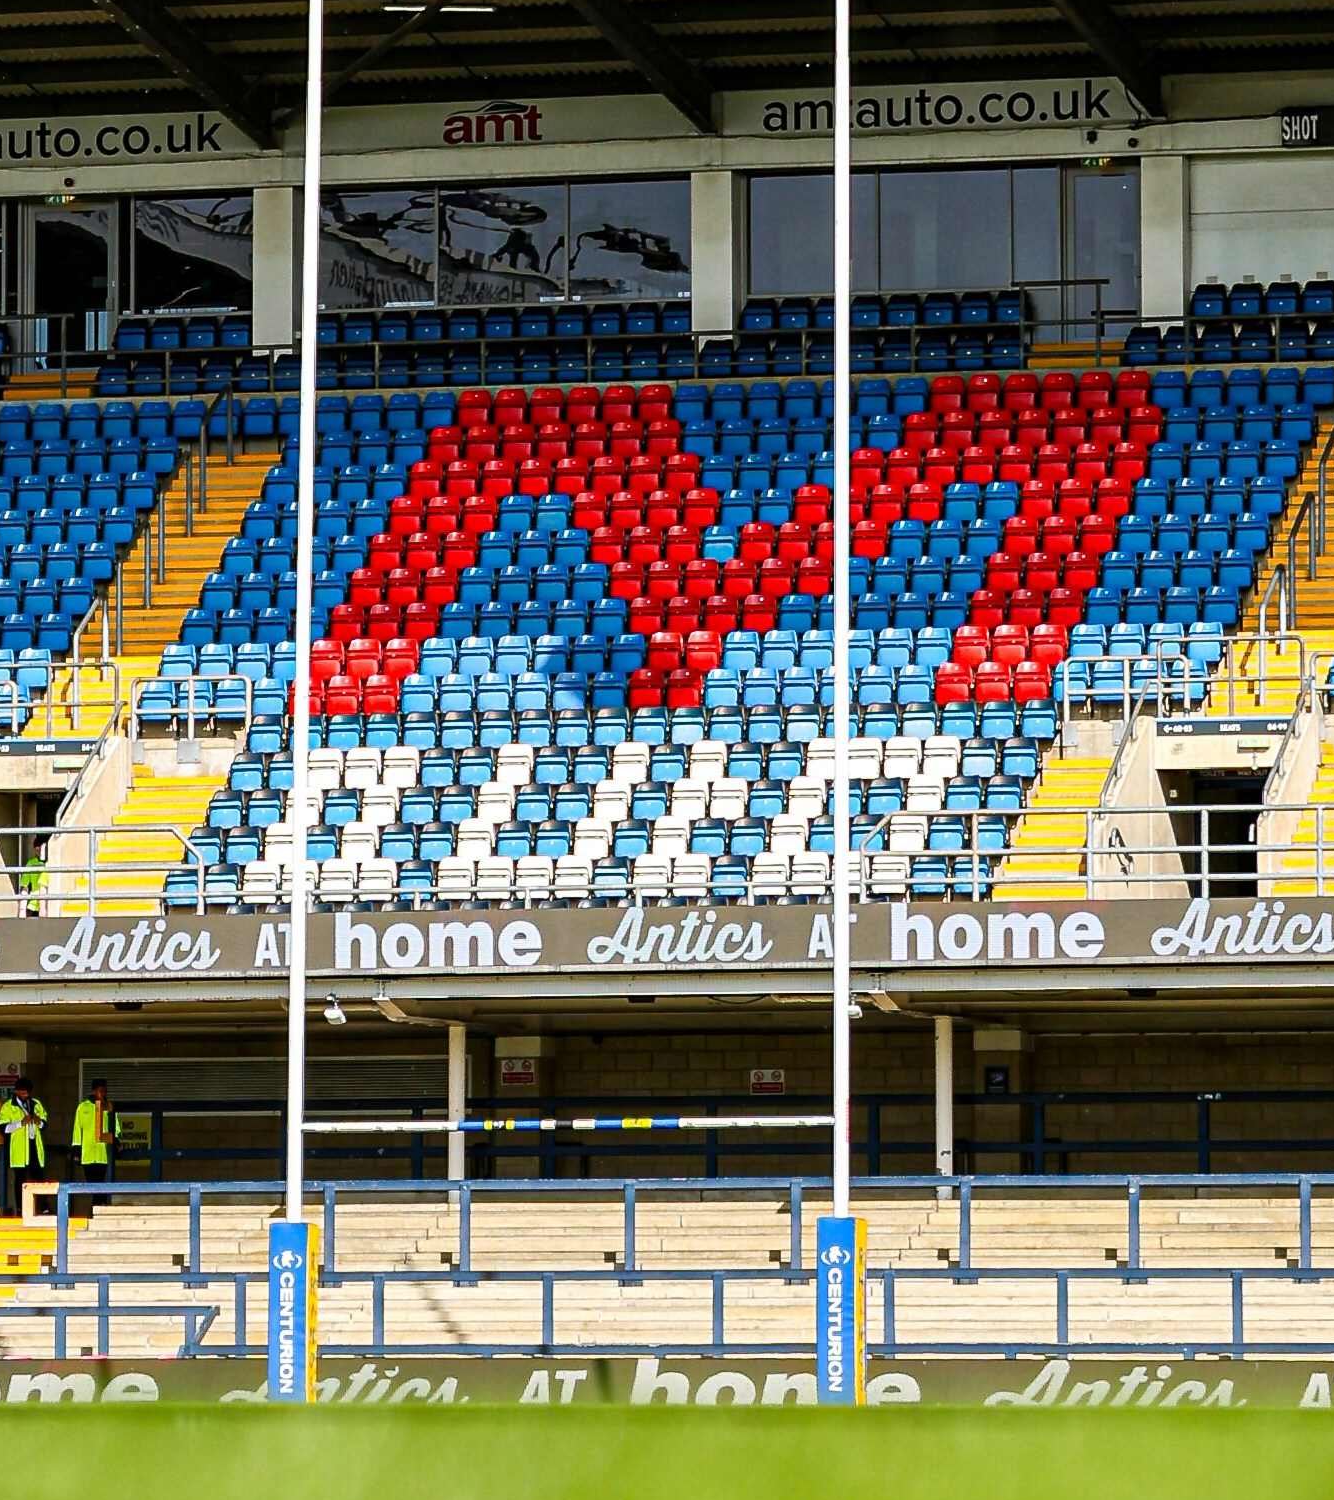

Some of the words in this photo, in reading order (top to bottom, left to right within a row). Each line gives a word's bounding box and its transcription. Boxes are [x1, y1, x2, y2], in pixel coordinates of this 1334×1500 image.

[443, 104, 543, 146] amt
[763, 79, 1111, 133] amauto.co.uk
[1282, 115, 1318, 140] SHOT
[40, 916, 221, 972] Antics
[335, 912, 543, 969] home
[586, 906, 773, 964] Antics
[890, 902, 1106, 961] home
[122, 1121, 134, 1130] NO
[279, 1271, 295, 1394] CENTURION
[827, 1267, 843, 1392] CENTURION
[519, 1369, 587, 1404] AT
